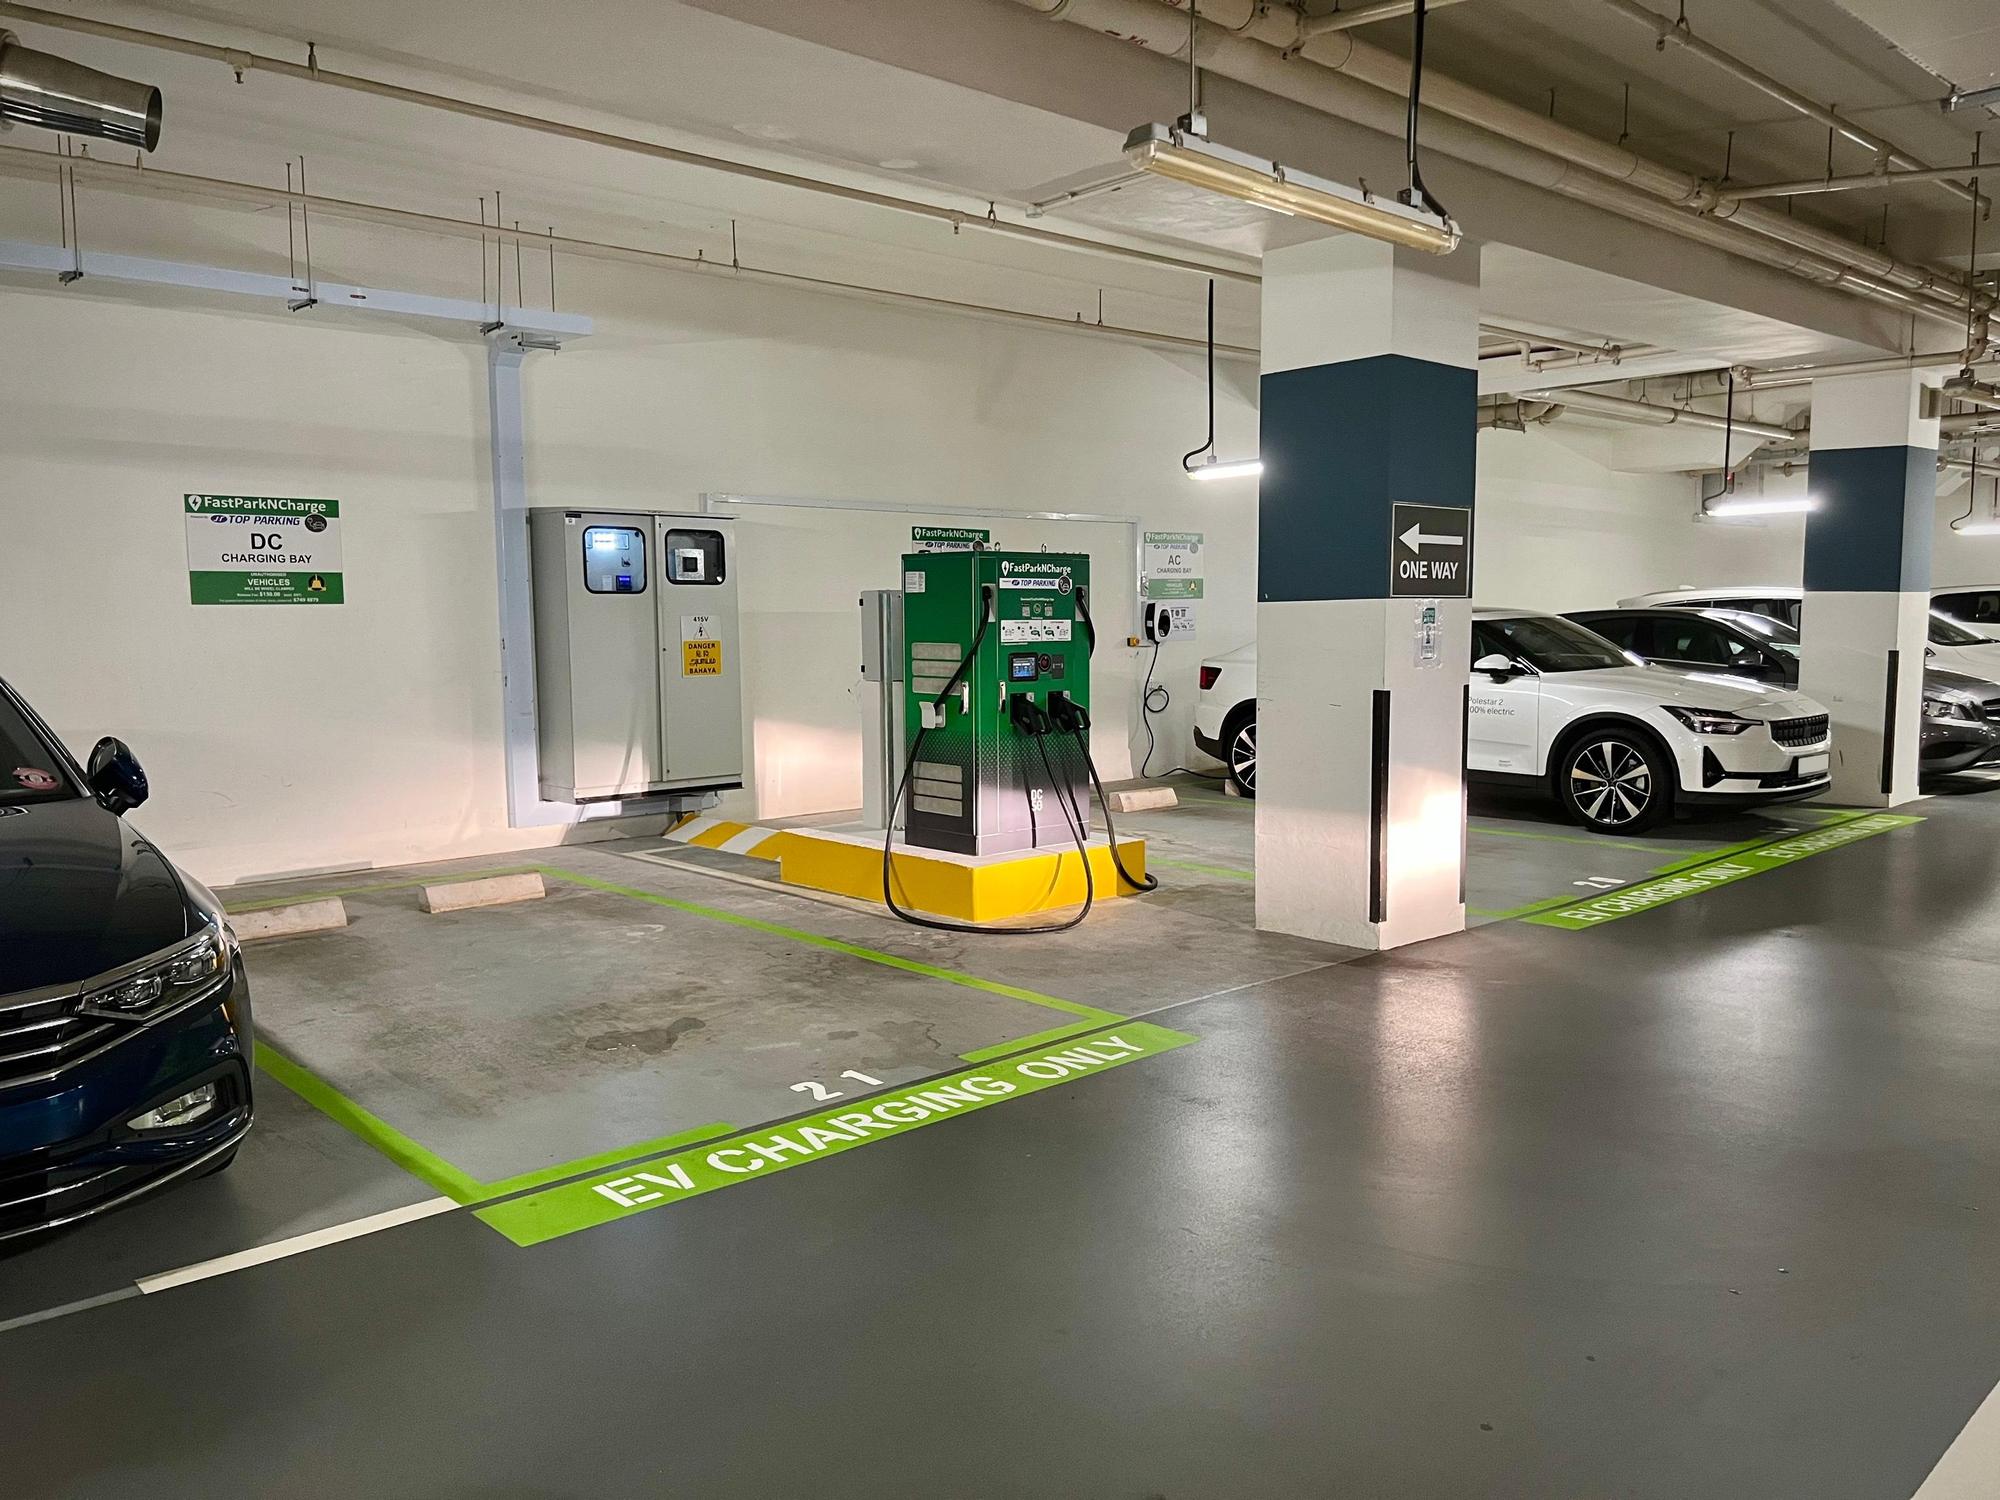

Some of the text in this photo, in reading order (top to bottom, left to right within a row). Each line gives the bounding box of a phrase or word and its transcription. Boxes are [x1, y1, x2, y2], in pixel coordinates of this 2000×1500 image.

[204, 496, 327, 513] FastParkNCharge
[229, 515, 250, 525] TOP
[254, 516, 301, 526] PARKING
[922, 528, 984, 541] FastParkNCharge
[250, 533, 283, 550] DC
[221, 554, 312, 564] CHARGING BAY
[1168, 555, 1181, 565] AC
[1009, 562, 1072, 576] FastParkNCharge
[1399, 560, 1458, 580] ONE WAY
[247, 578, 290, 586] VEHICLES
[1021, 579, 1031, 587] TOP
[1032, 579, 1056, 587] PARKING
[1498, 698, 1504, 706] 2
[1487, 707, 1515, 716] electric
[1031, 789, 1043, 800] DC
[1572, 876, 1626, 889] 20
[1557, 862, 1754, 921] EV CHARGING ONLY
[592, 1035, 1144, 1208] EV CHARGING ONLY
